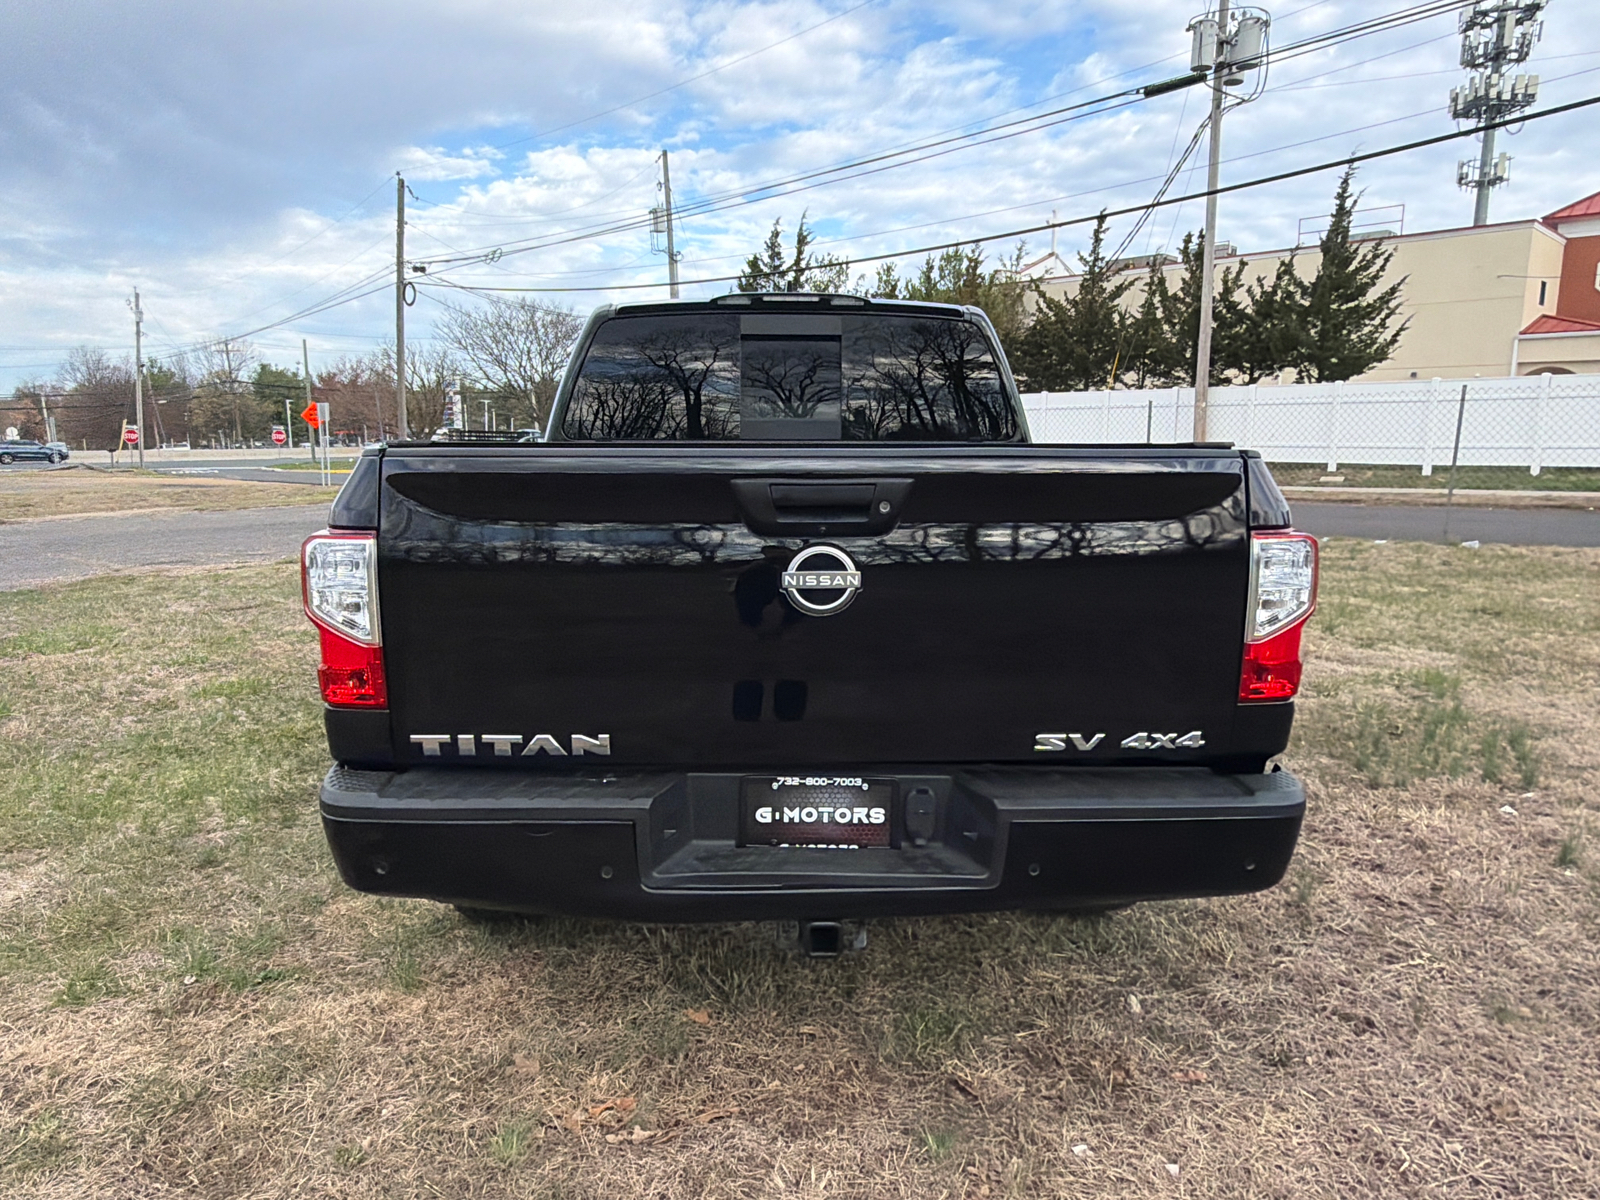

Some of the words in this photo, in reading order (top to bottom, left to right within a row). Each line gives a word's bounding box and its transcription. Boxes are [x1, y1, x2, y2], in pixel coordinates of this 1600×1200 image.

[124, 432, 139, 440] STOP
[272, 432, 287, 440] STOP
[784, 575, 859, 586] NISSAN
[409, 734, 611, 756] TITAN
[1034, 733, 1106, 751] SV
[776, 776, 862, 787] 732-800-7003
